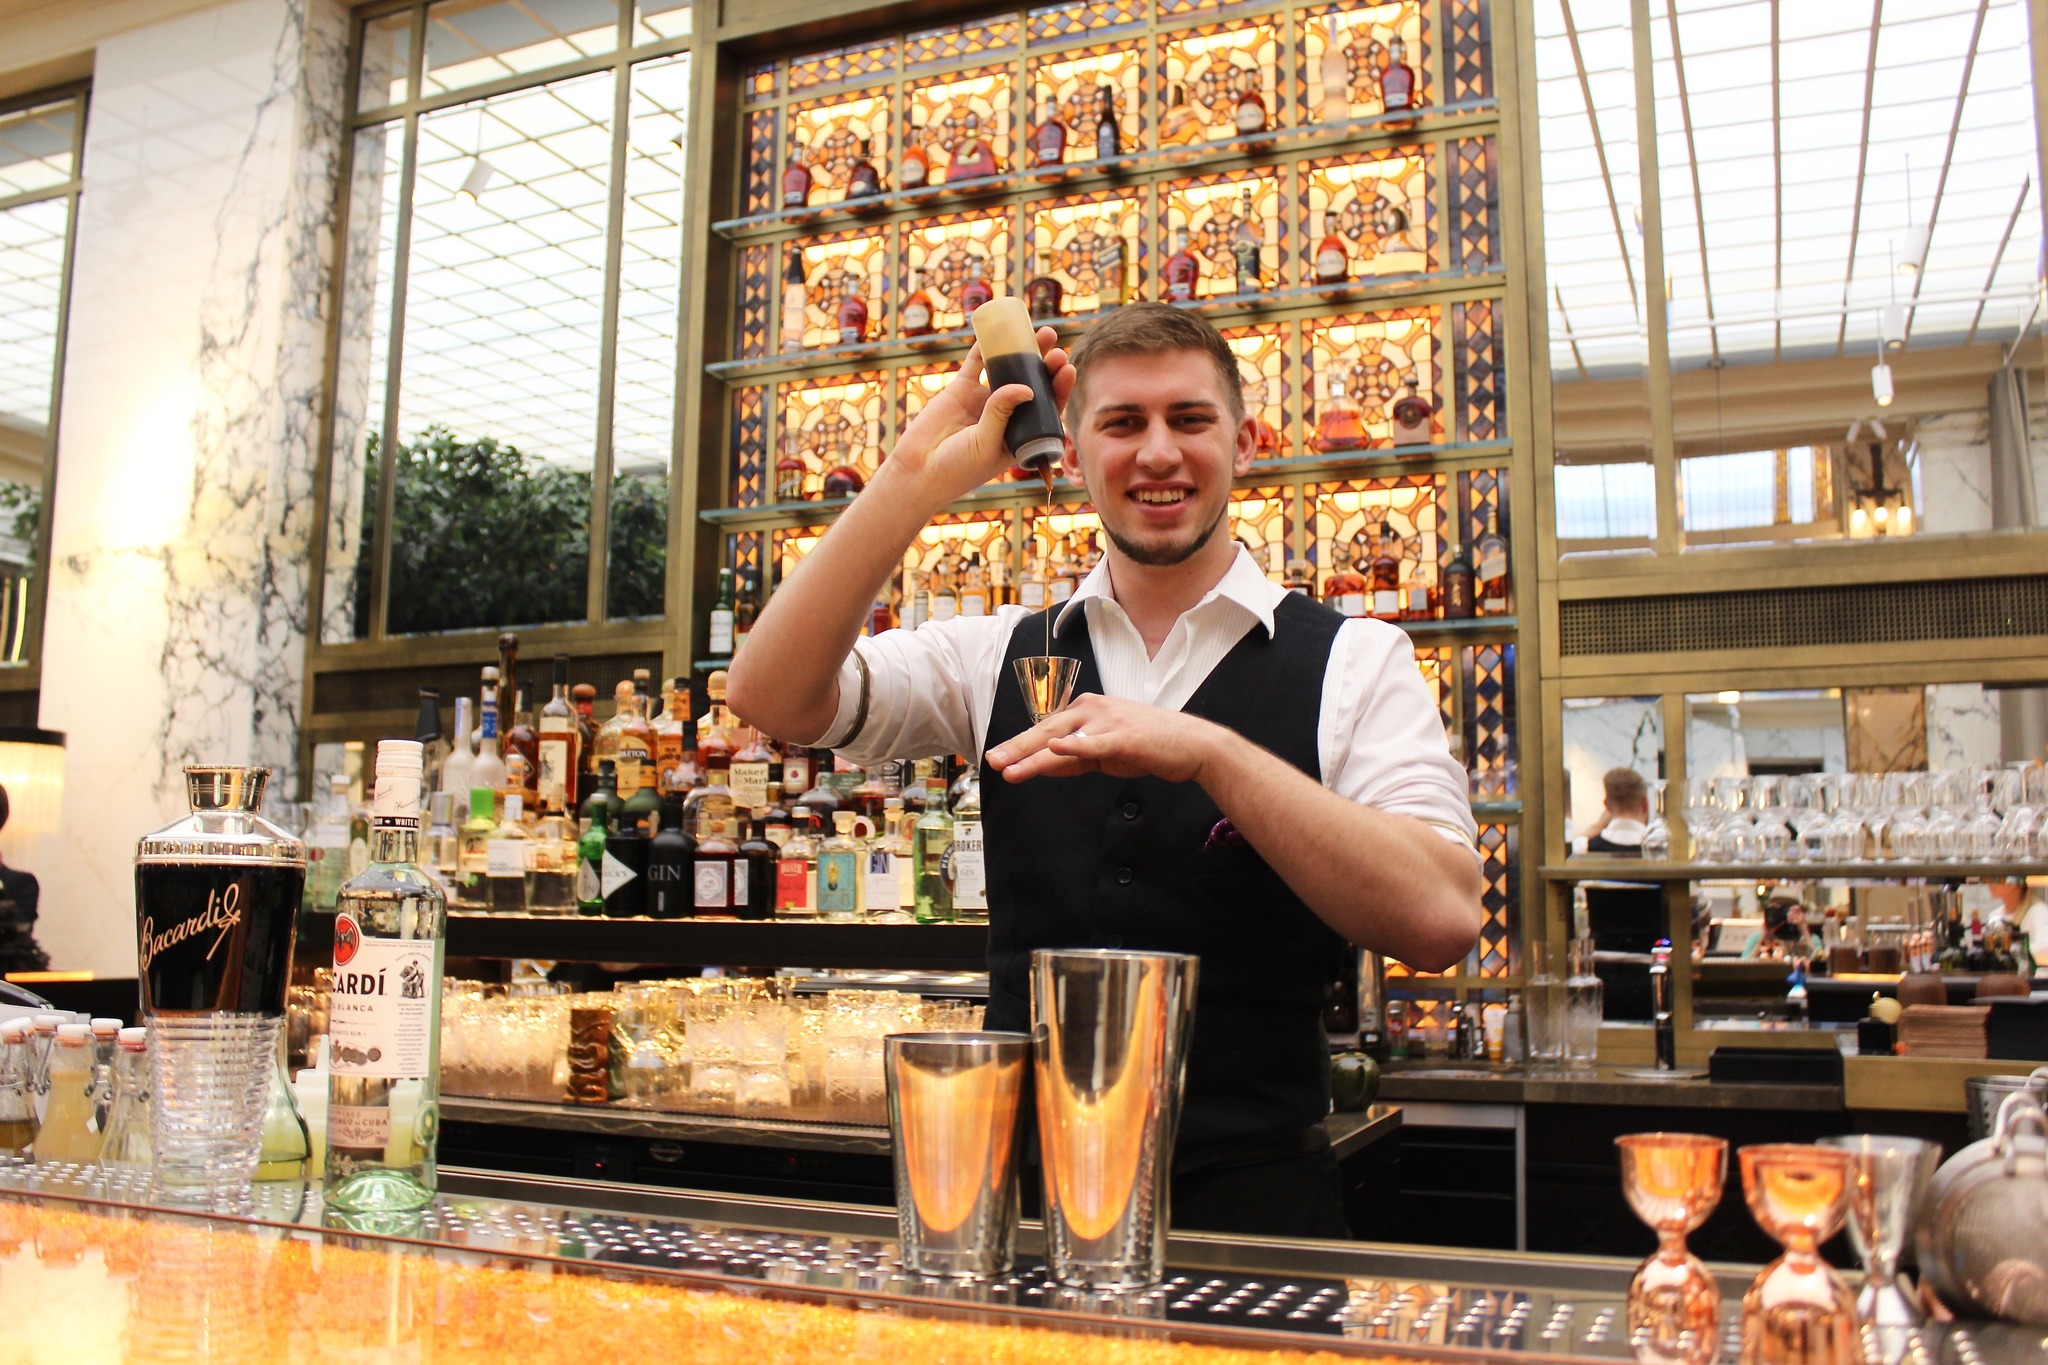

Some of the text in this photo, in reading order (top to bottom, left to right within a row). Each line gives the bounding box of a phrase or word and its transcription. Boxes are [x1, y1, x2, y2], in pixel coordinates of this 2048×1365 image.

[394, 818, 414, 826] WHITE
[869, 853, 890, 874] GIN
[647, 864, 682, 882] GIN
[337, 1004, 374, 1012] BLANCA
[362, 1118, 388, 1126] CUBA
